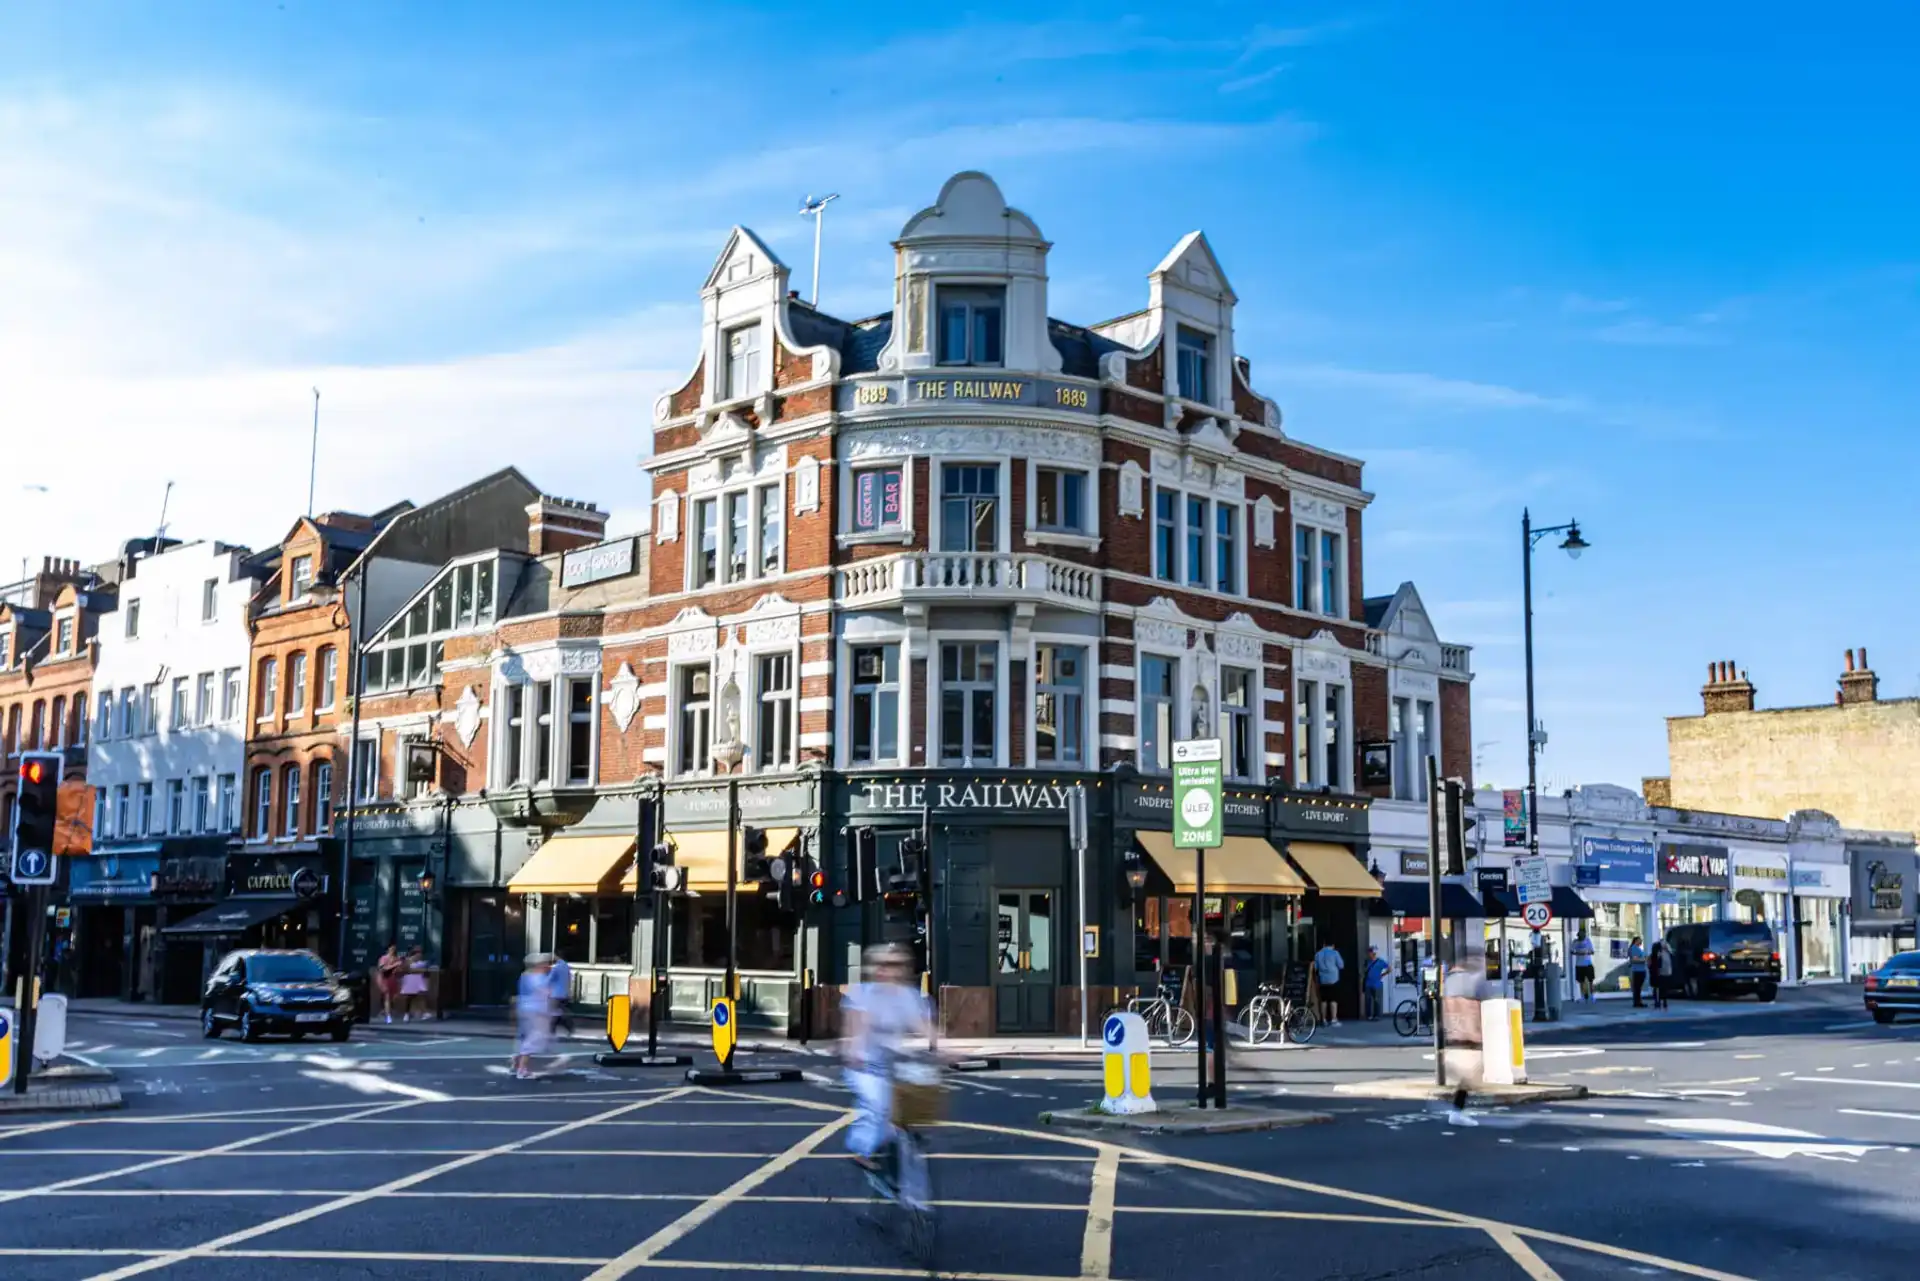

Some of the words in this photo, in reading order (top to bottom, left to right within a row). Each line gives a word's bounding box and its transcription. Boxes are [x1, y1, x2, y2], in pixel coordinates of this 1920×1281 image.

[854, 384, 889, 404] 1889
[917, 381, 947, 399] THE
[953, 381, 1022, 400] RAILWAY
[1055, 387, 1088, 408] 1889
[885, 483, 898, 513] BAR
[1178, 766, 1200, 777] Ultra
[1201, 765, 1217, 776] low
[1179, 777, 1215, 786] emission
[862, 784, 927, 808] THE
[937, 783, 1070, 809] RAILWAY
[1138, 796, 1174, 809] INDEPE
[1185, 803, 1210, 813] ULEZ
[1224, 803, 1260, 816] KITCHEN
[1305, 810, 1321, 821] LIVE
[1322, 811, 1345, 823] SPORT
[1182, 830, 1213, 843] ZONE
[1709, 856, 1728, 875] VAPE
[1528, 908, 1548, 921] 20
